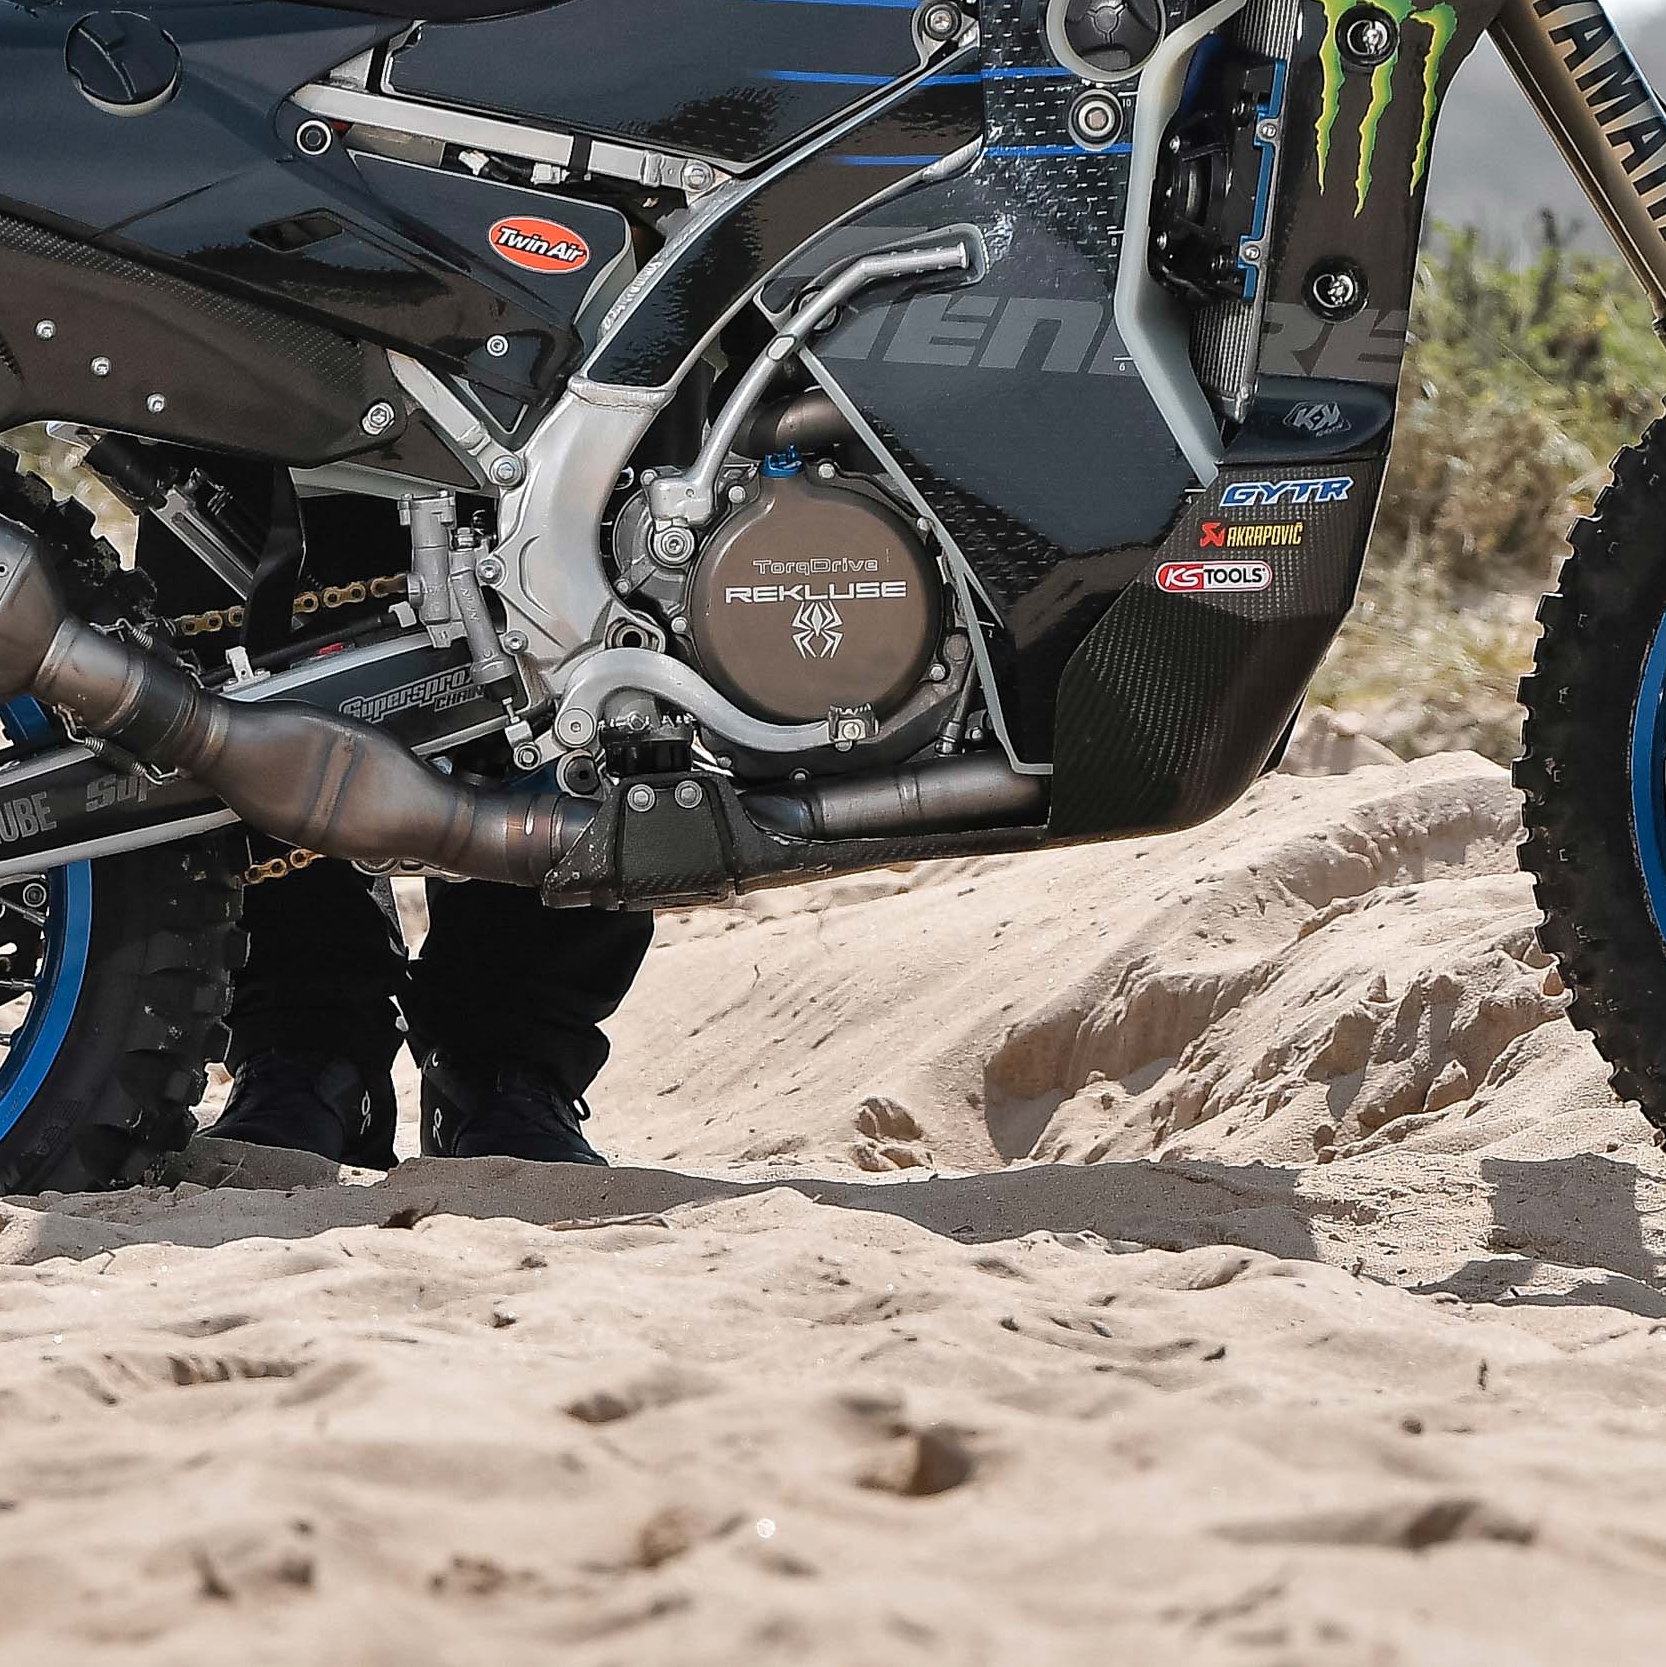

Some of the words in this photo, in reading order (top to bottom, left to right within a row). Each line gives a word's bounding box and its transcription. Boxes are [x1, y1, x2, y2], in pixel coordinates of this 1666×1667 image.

[498, 227, 549, 254] Twin
[546, 241, 584, 262] Air
[1219, 476, 1354, 507] GYTR
[1226, 521, 1304, 548] AKRAPOVIČ
[753, 557, 879, 576] TorqDrive
[1164, 567, 1203, 589] KS
[1204, 568, 1264, 585] TOOLS
[725, 580, 908, 605] REKLUSE
[342, 669, 469, 721] Superspro
